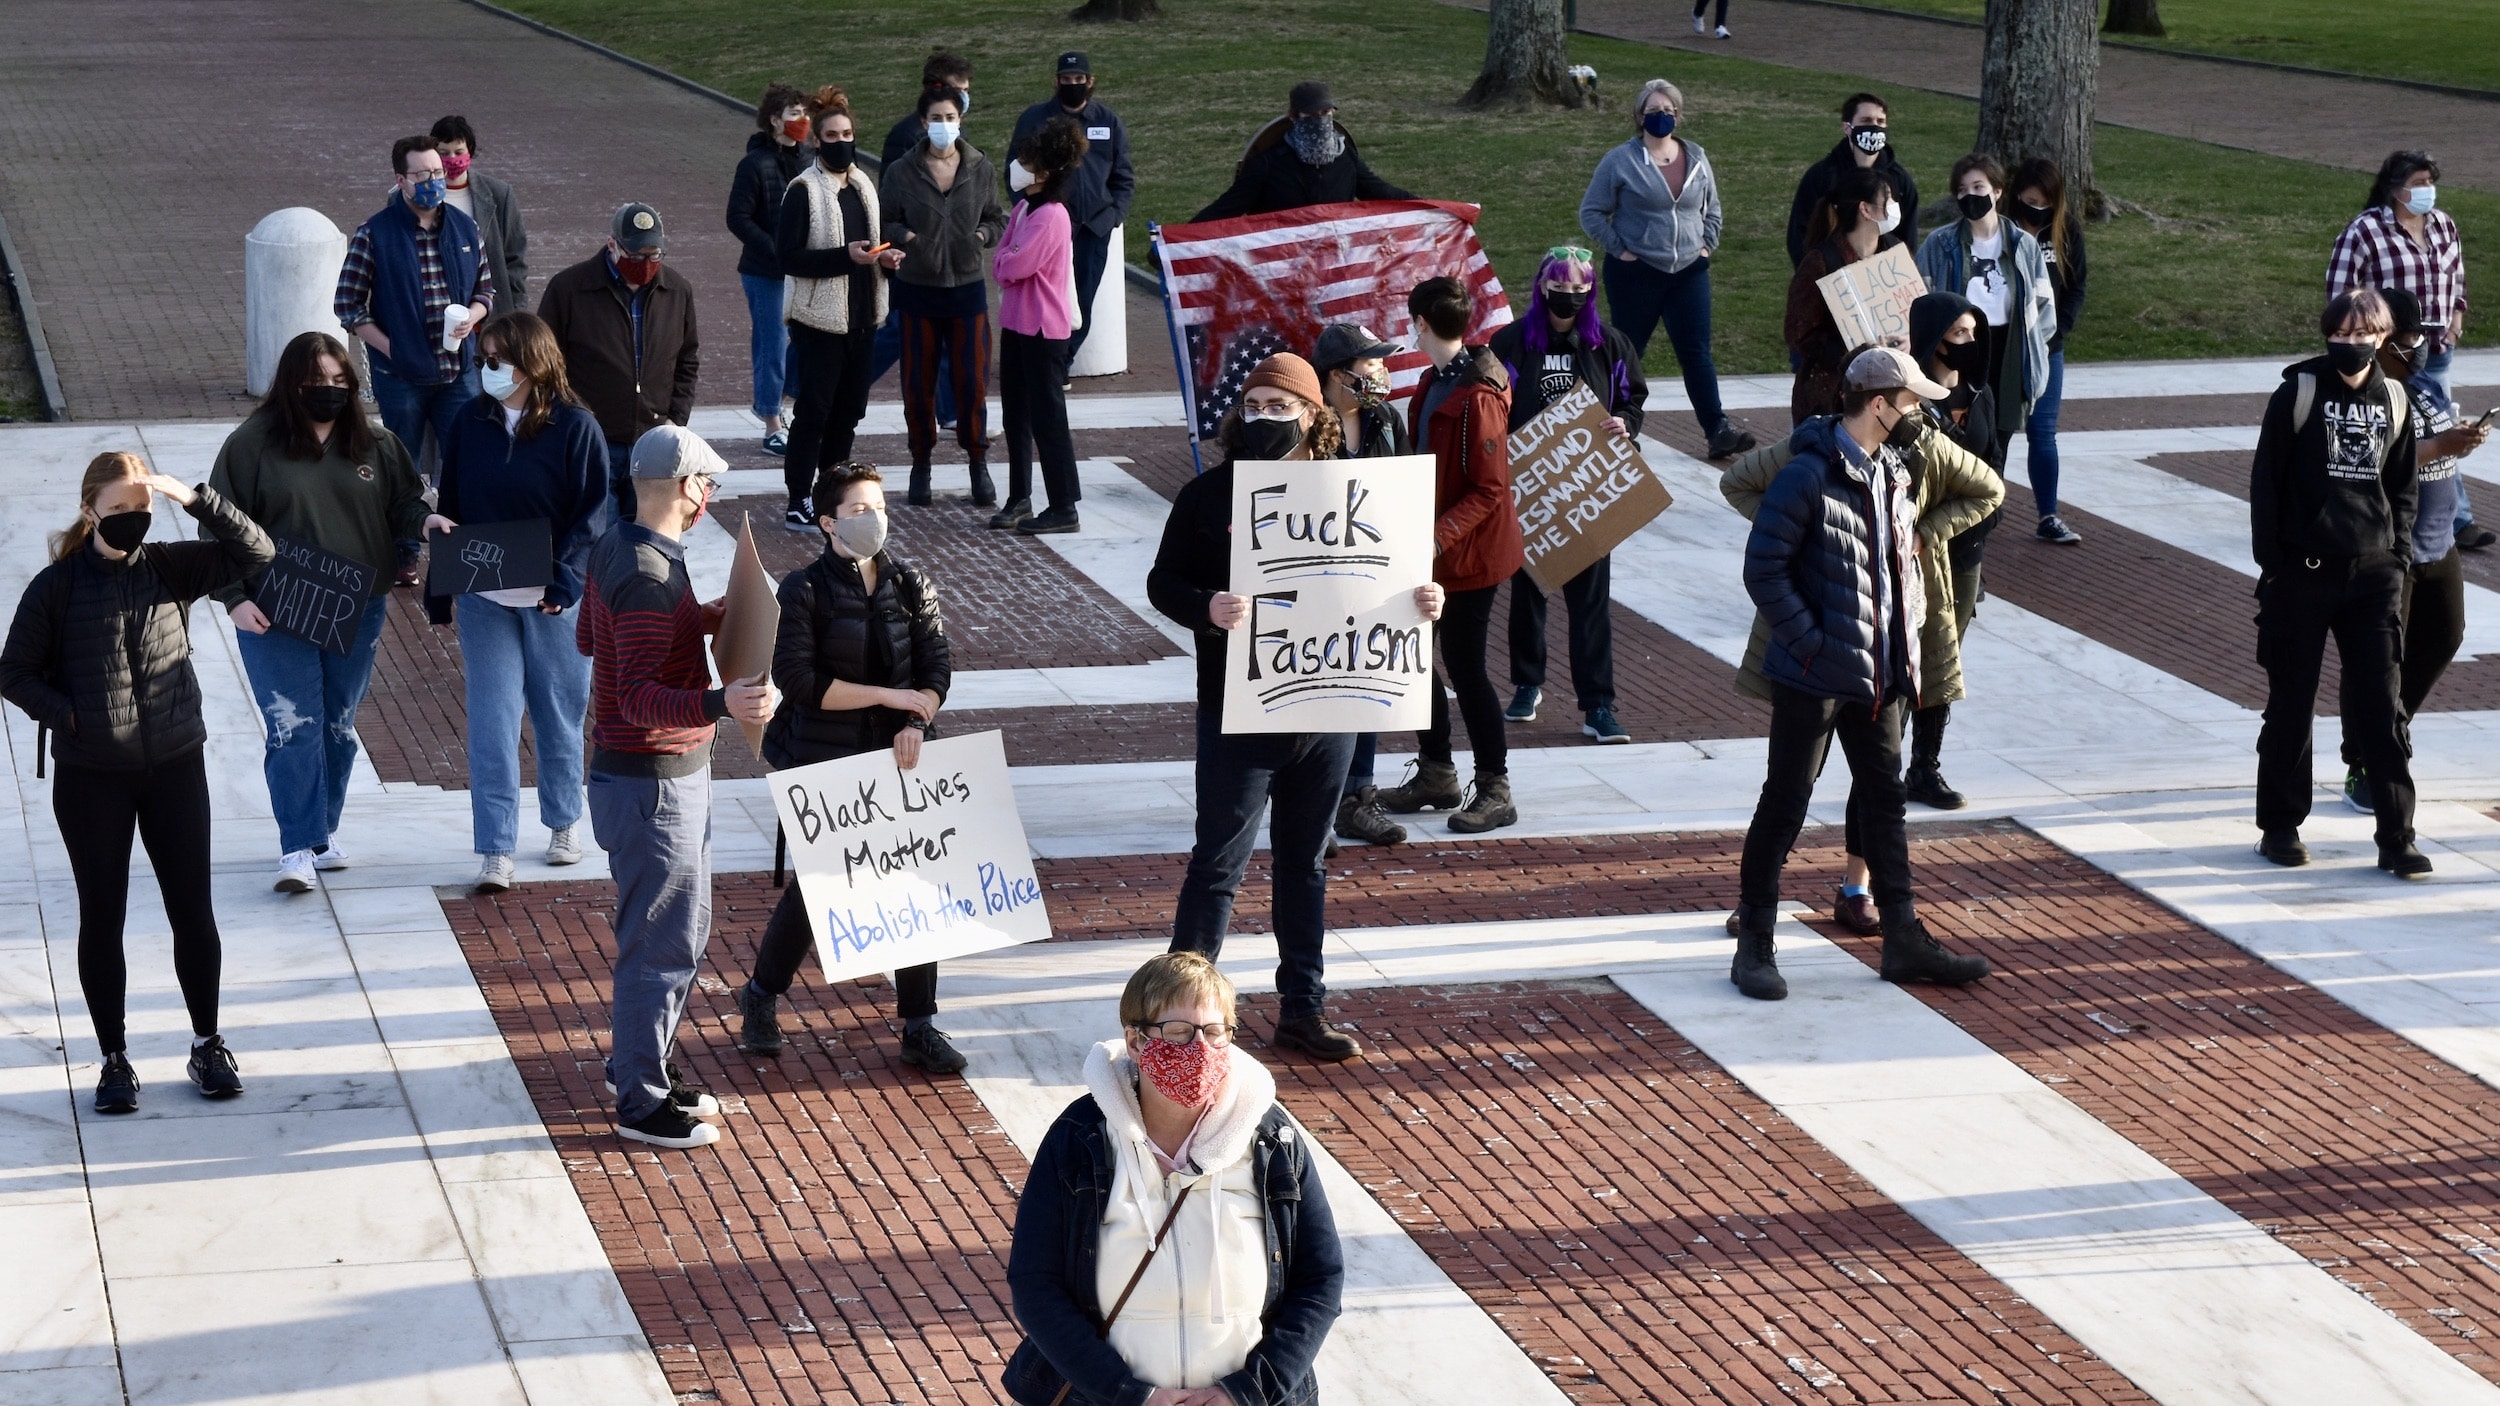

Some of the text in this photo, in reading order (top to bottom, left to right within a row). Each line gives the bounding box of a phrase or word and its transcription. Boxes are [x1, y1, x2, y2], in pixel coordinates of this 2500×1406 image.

[1507, 384, 1600, 466] ILITARIZE
[1250, 478, 1383, 551] Fuck
[1523, 462, 1645, 567] THE POLICE
[276, 537, 362, 592] BLACK LIVES
[256, 567, 346, 655] MATTER
[1247, 590, 1427, 682] Fascism
[787, 766, 971, 845] Black Lives
[843, 826, 956, 889] Matter
[828, 861, 1041, 963] Abolish the Police
